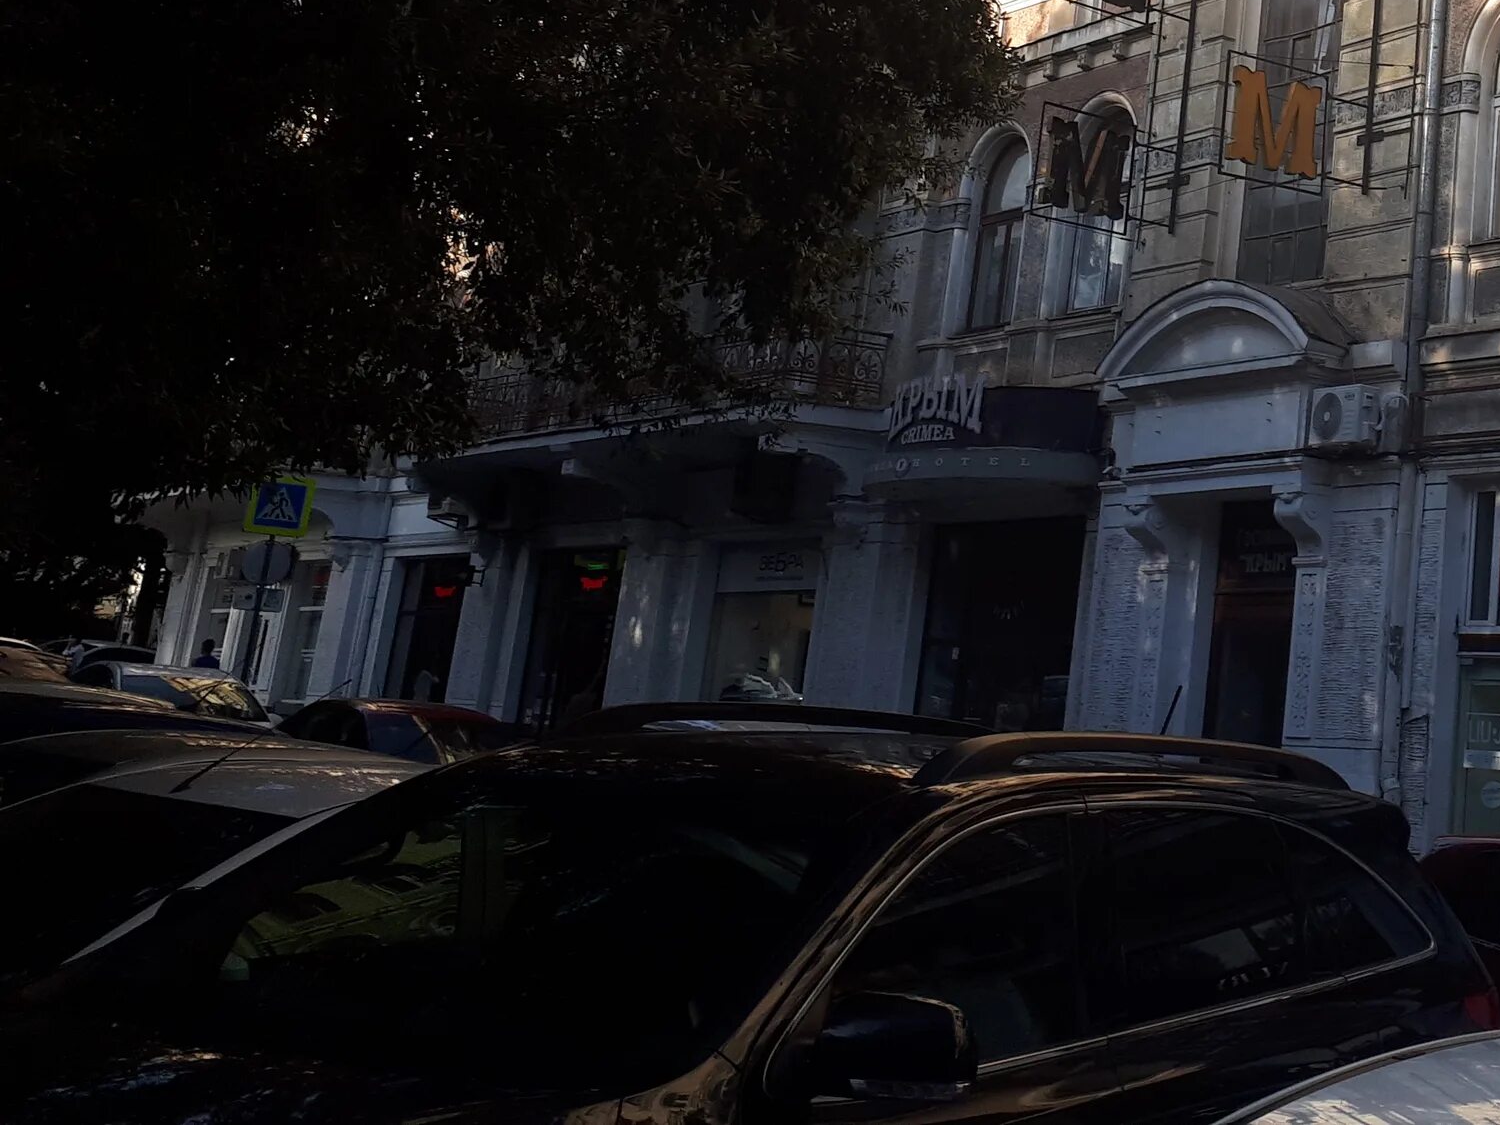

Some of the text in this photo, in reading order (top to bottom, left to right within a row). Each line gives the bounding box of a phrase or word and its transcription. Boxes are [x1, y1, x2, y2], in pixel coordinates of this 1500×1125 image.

[888, 374, 988, 442] КРЫМ
[901, 424, 955, 445] CRIMEA
[912, 456, 1031, 468] HOTEL
